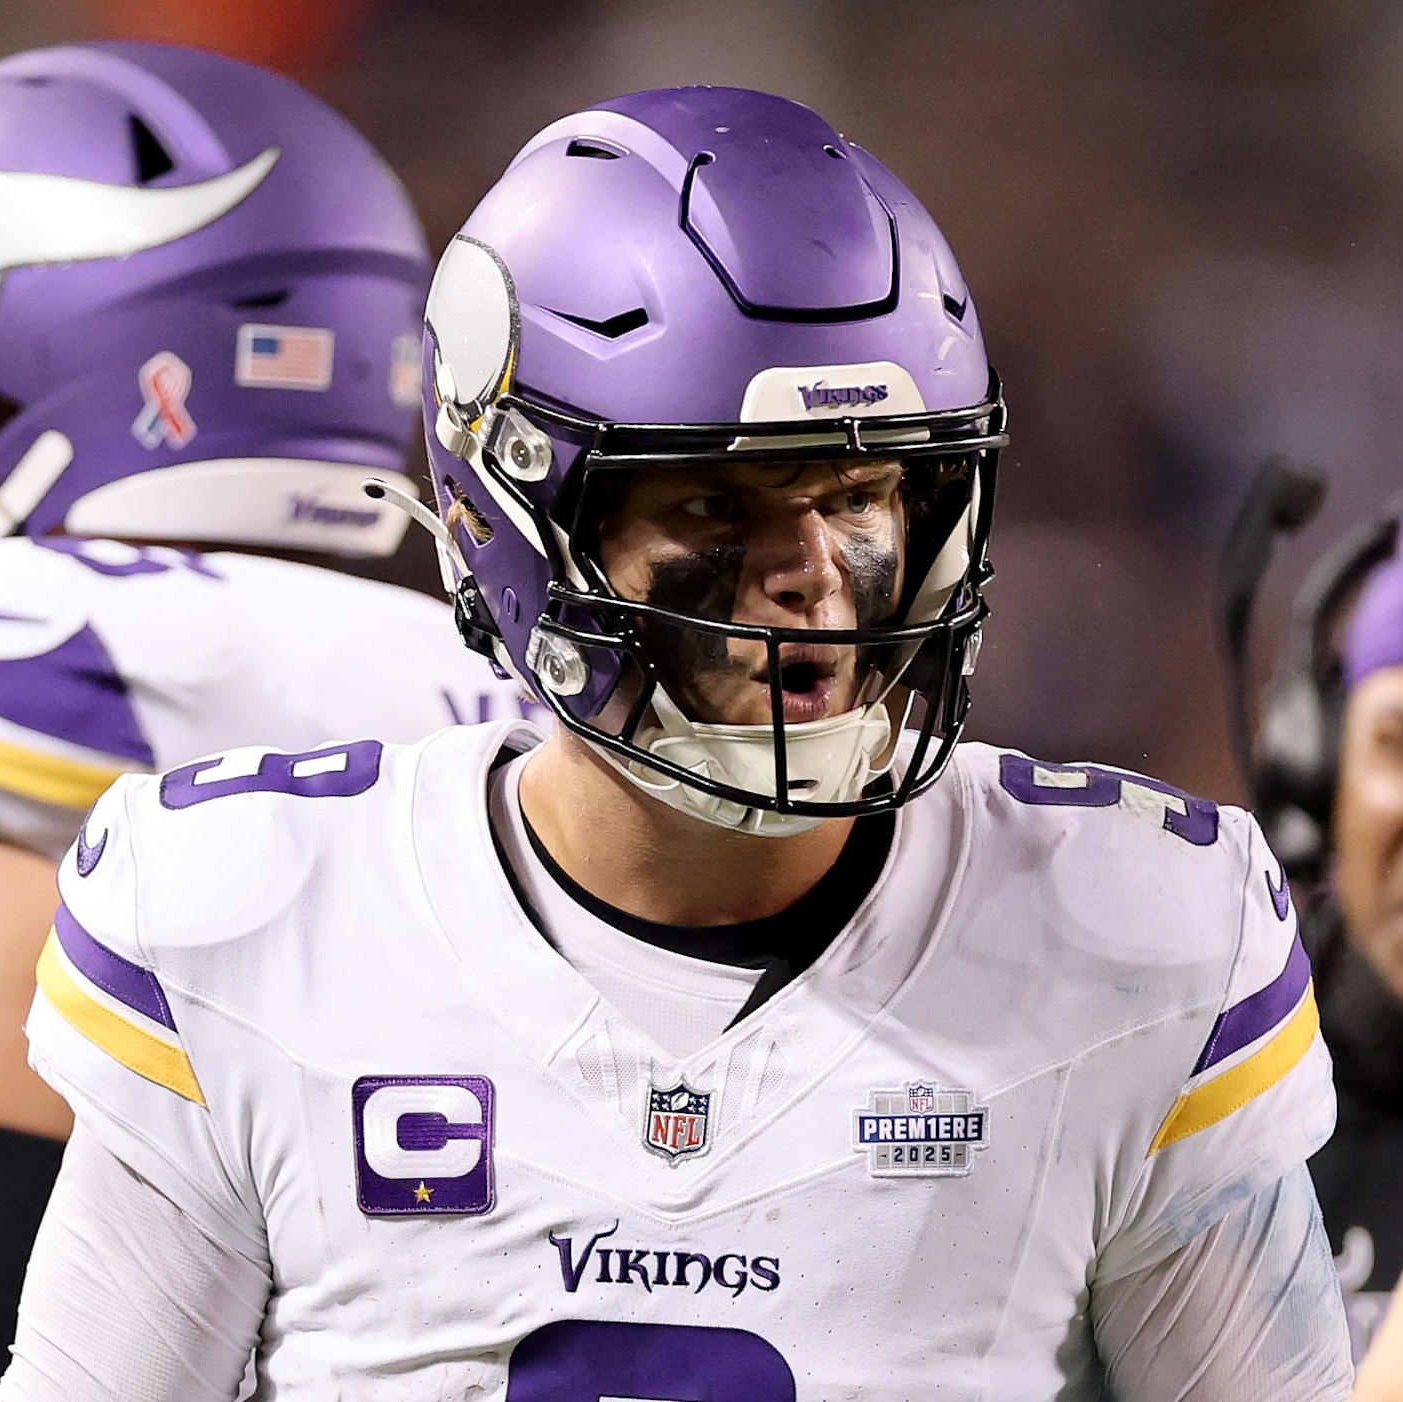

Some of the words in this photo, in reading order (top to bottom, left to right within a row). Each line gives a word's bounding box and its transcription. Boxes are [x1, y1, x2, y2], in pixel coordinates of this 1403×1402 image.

[912, 1098, 933, 1108] NFL
[363, 1085, 483, 1180] C
[652, 1114, 700, 1149] NFL
